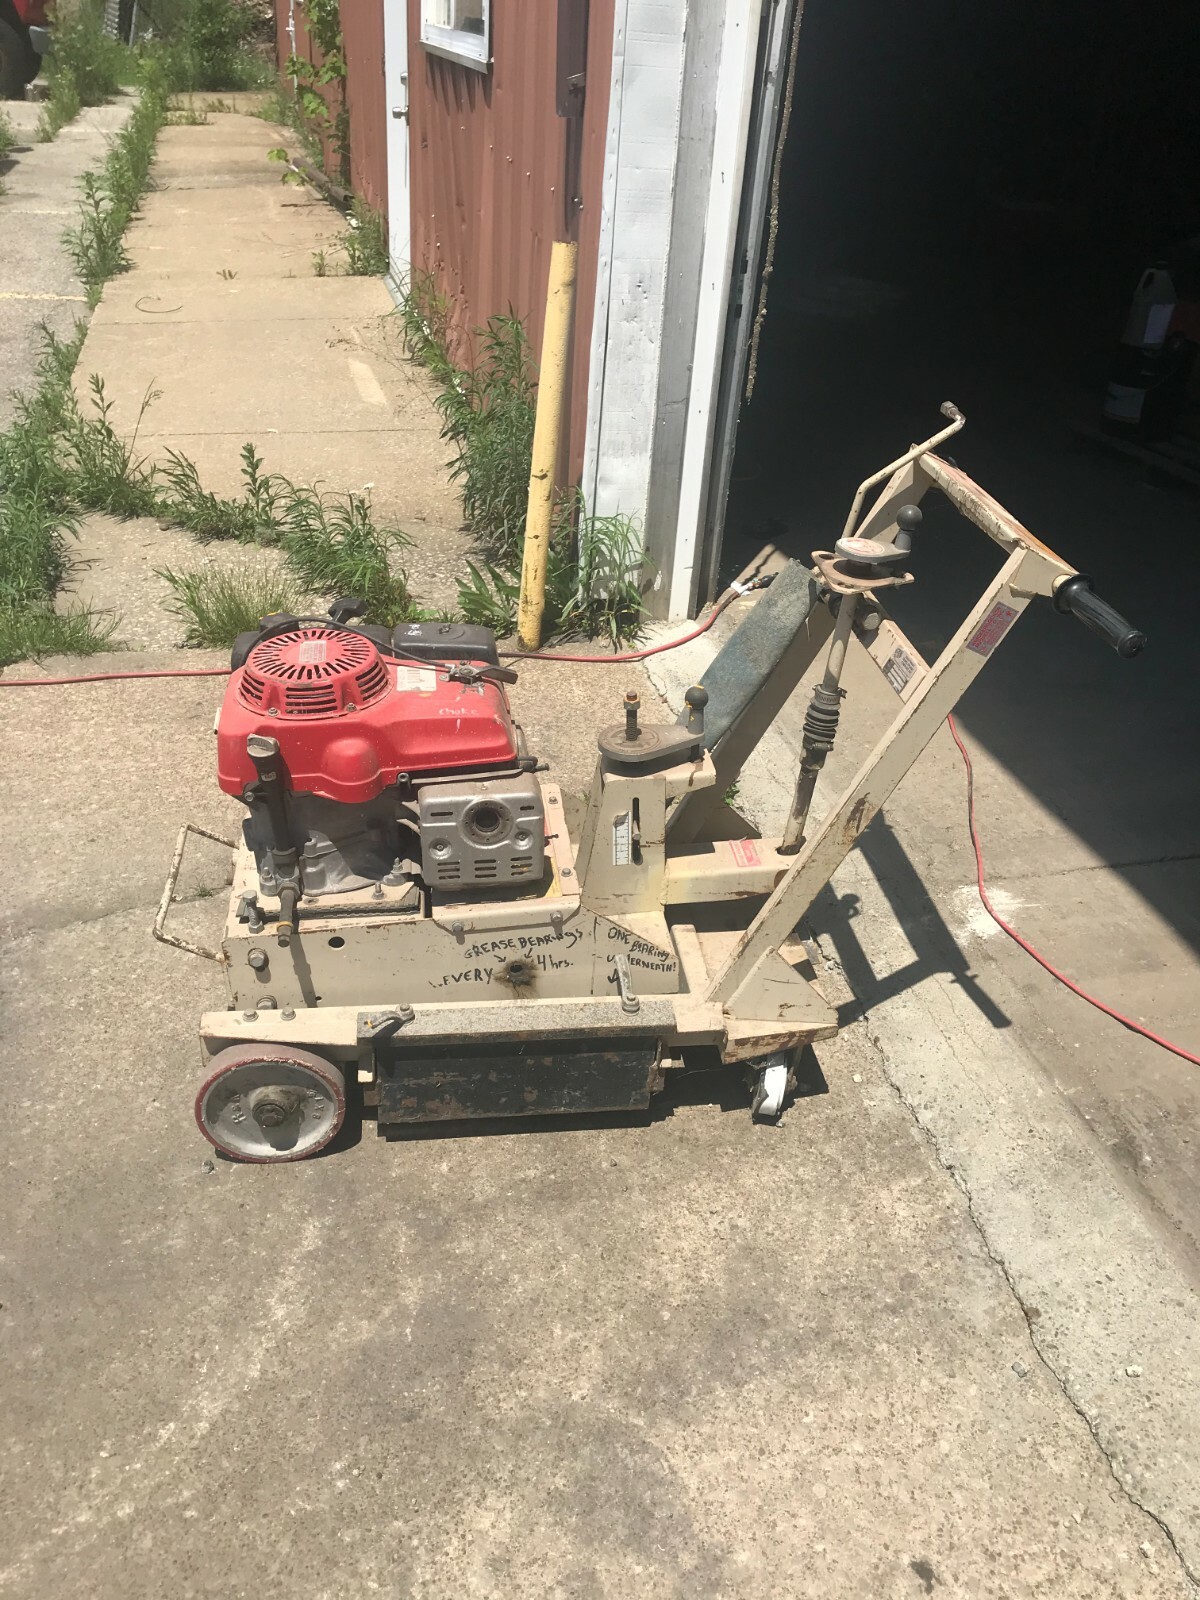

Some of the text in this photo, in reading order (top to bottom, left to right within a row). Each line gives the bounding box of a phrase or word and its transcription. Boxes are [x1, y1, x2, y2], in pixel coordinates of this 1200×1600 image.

[608, 926, 631, 944] ONE
[464, 938, 515, 959] GREASE
[536, 954, 546, 971] 4
